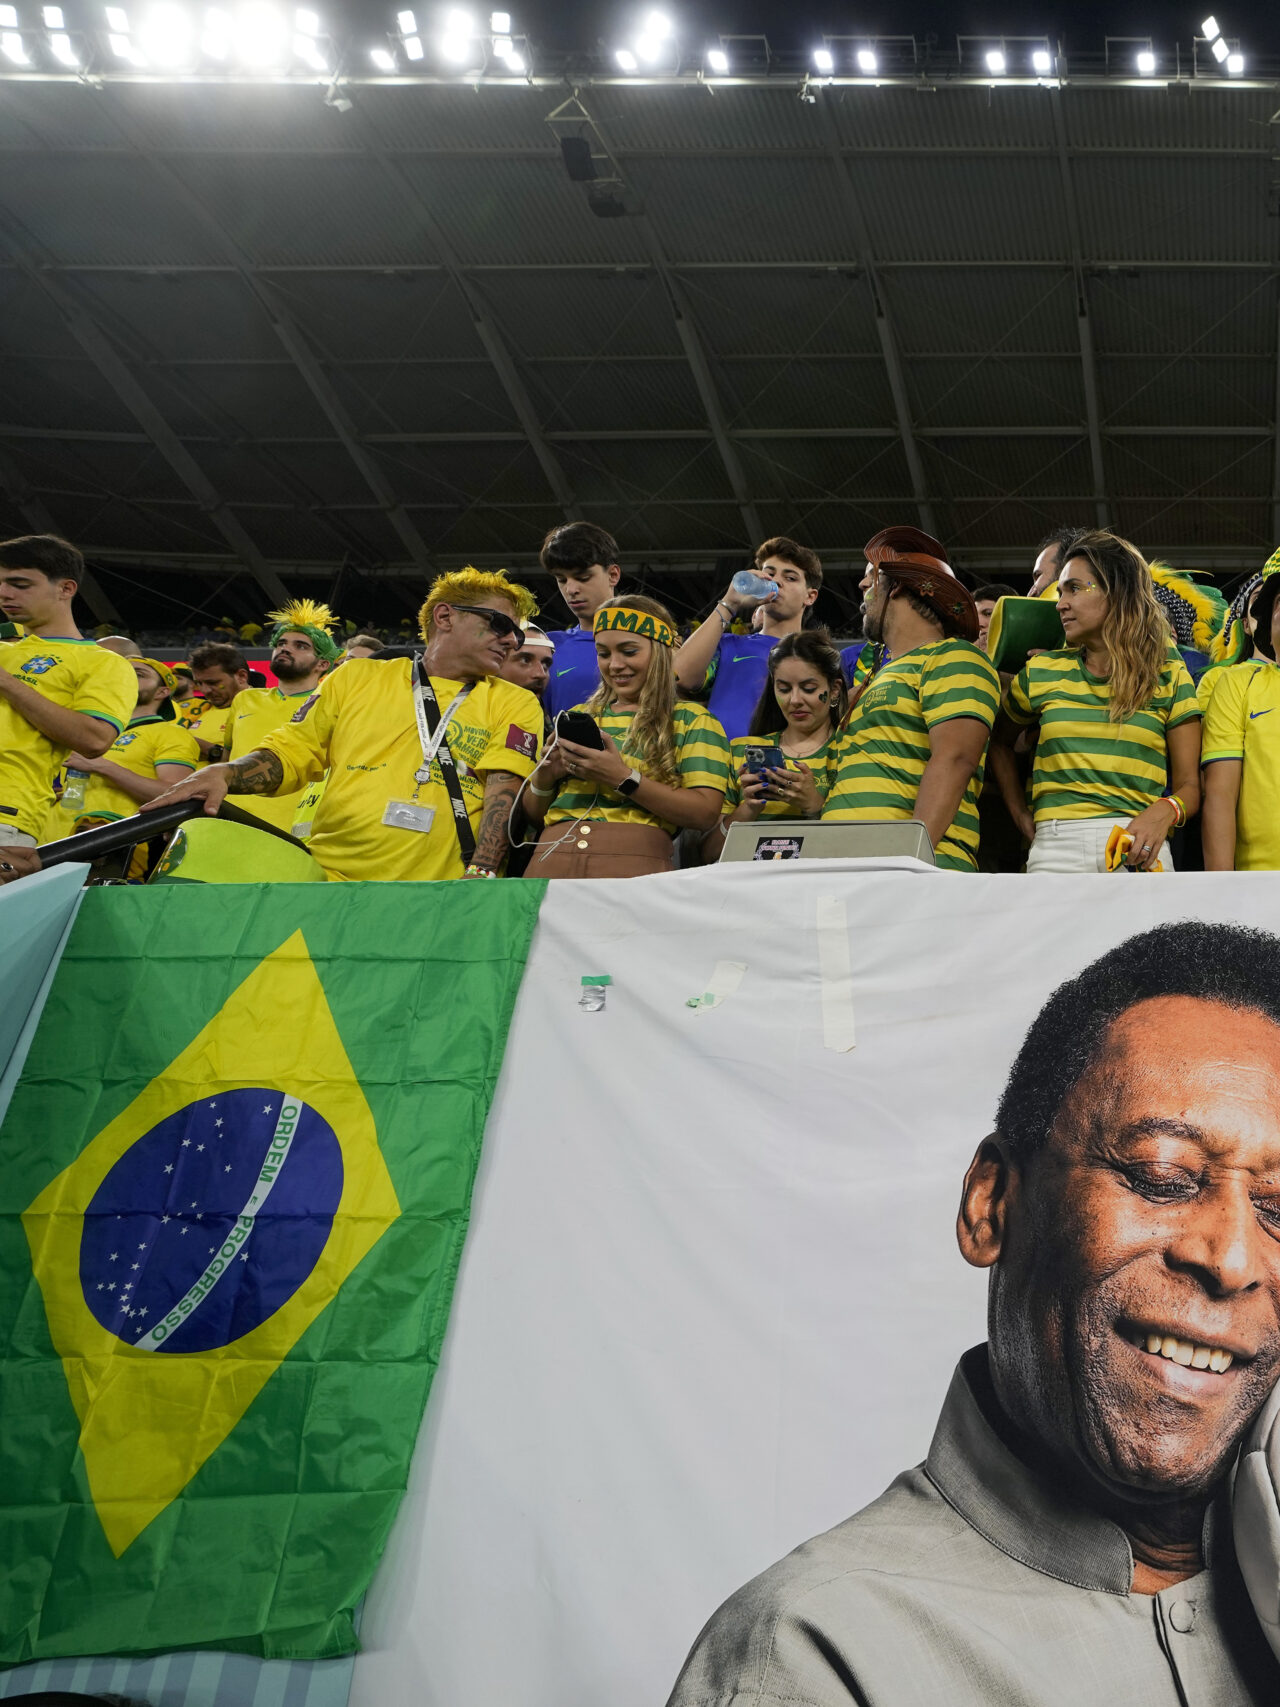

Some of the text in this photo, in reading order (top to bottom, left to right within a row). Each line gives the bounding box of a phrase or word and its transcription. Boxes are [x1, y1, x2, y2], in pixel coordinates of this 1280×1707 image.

[437, 746, 454, 766] NIKE
[450, 797, 468, 819] NIKE
[151, 1105, 298, 1341] ORDEM E PROGRESSO
